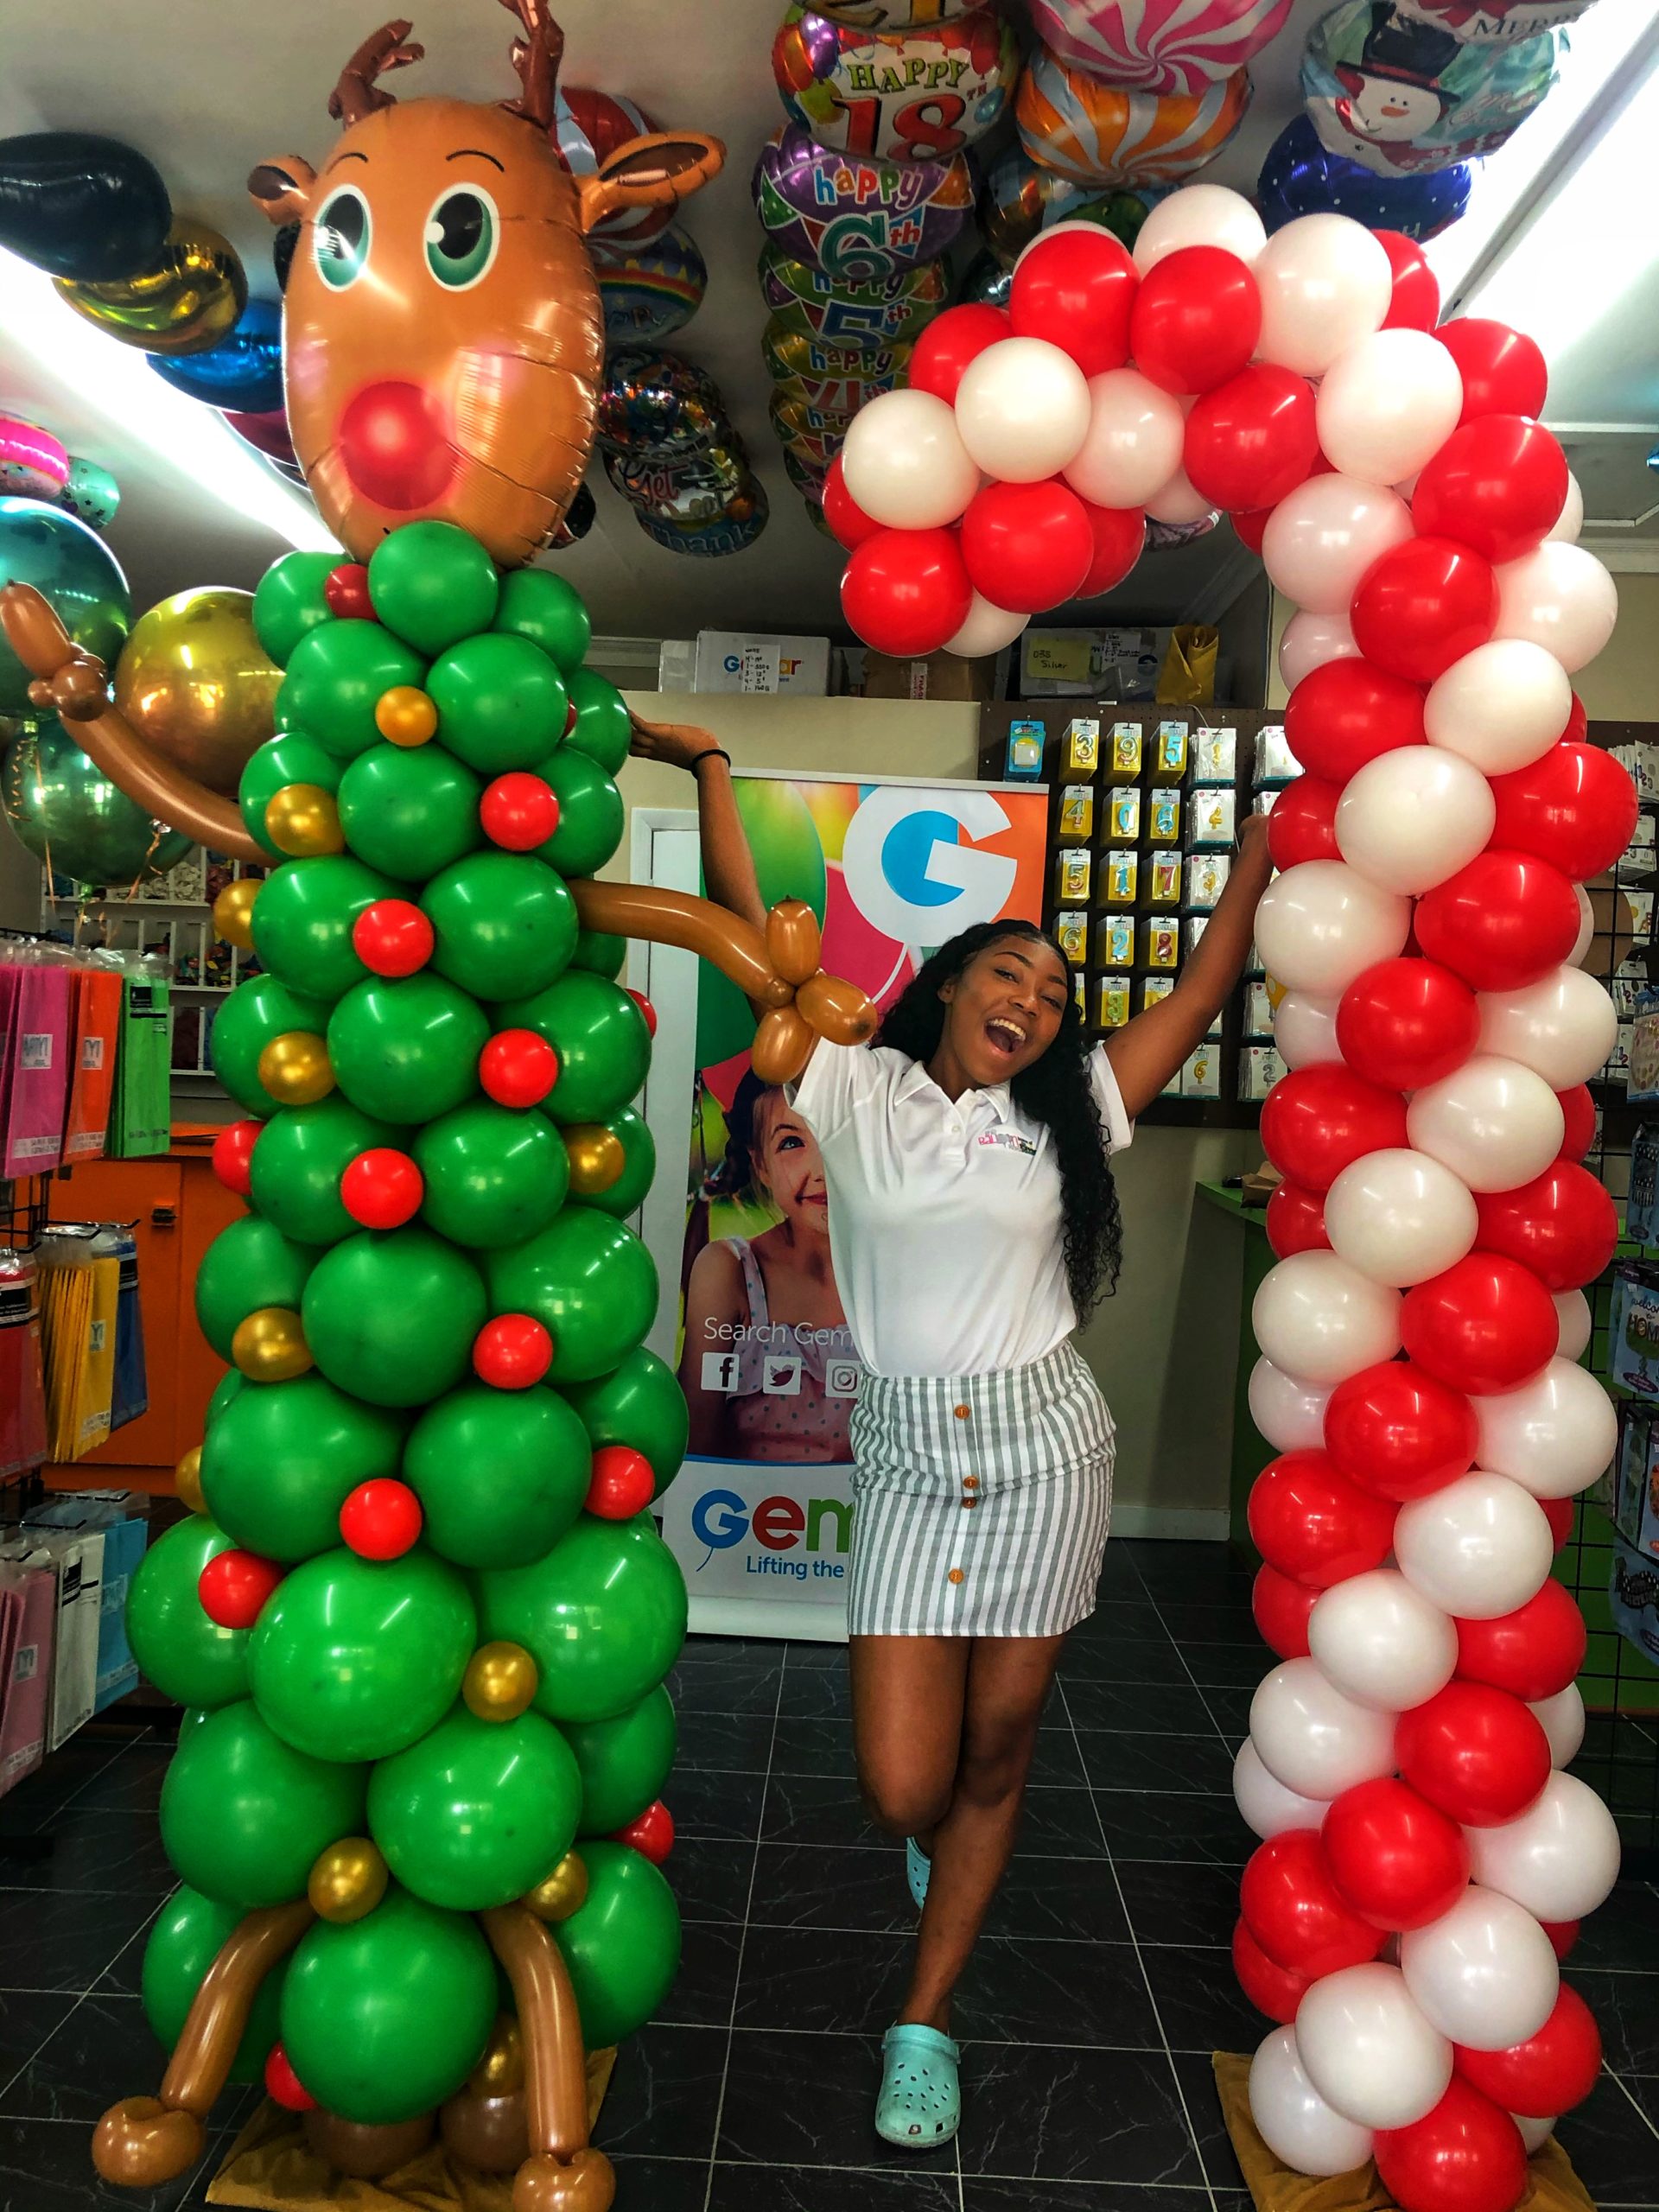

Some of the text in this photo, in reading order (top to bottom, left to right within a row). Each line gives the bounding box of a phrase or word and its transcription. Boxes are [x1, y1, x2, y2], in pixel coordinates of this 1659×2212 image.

[847, 58, 969, 94] HAPPY
[814, 165, 924, 210] happy
[810, 343, 893, 377] happy
[704, 1317, 853, 1346] Search Gem
[692, 1489, 854, 1554] Gem
[747, 1555, 844, 1580] Lifting the
